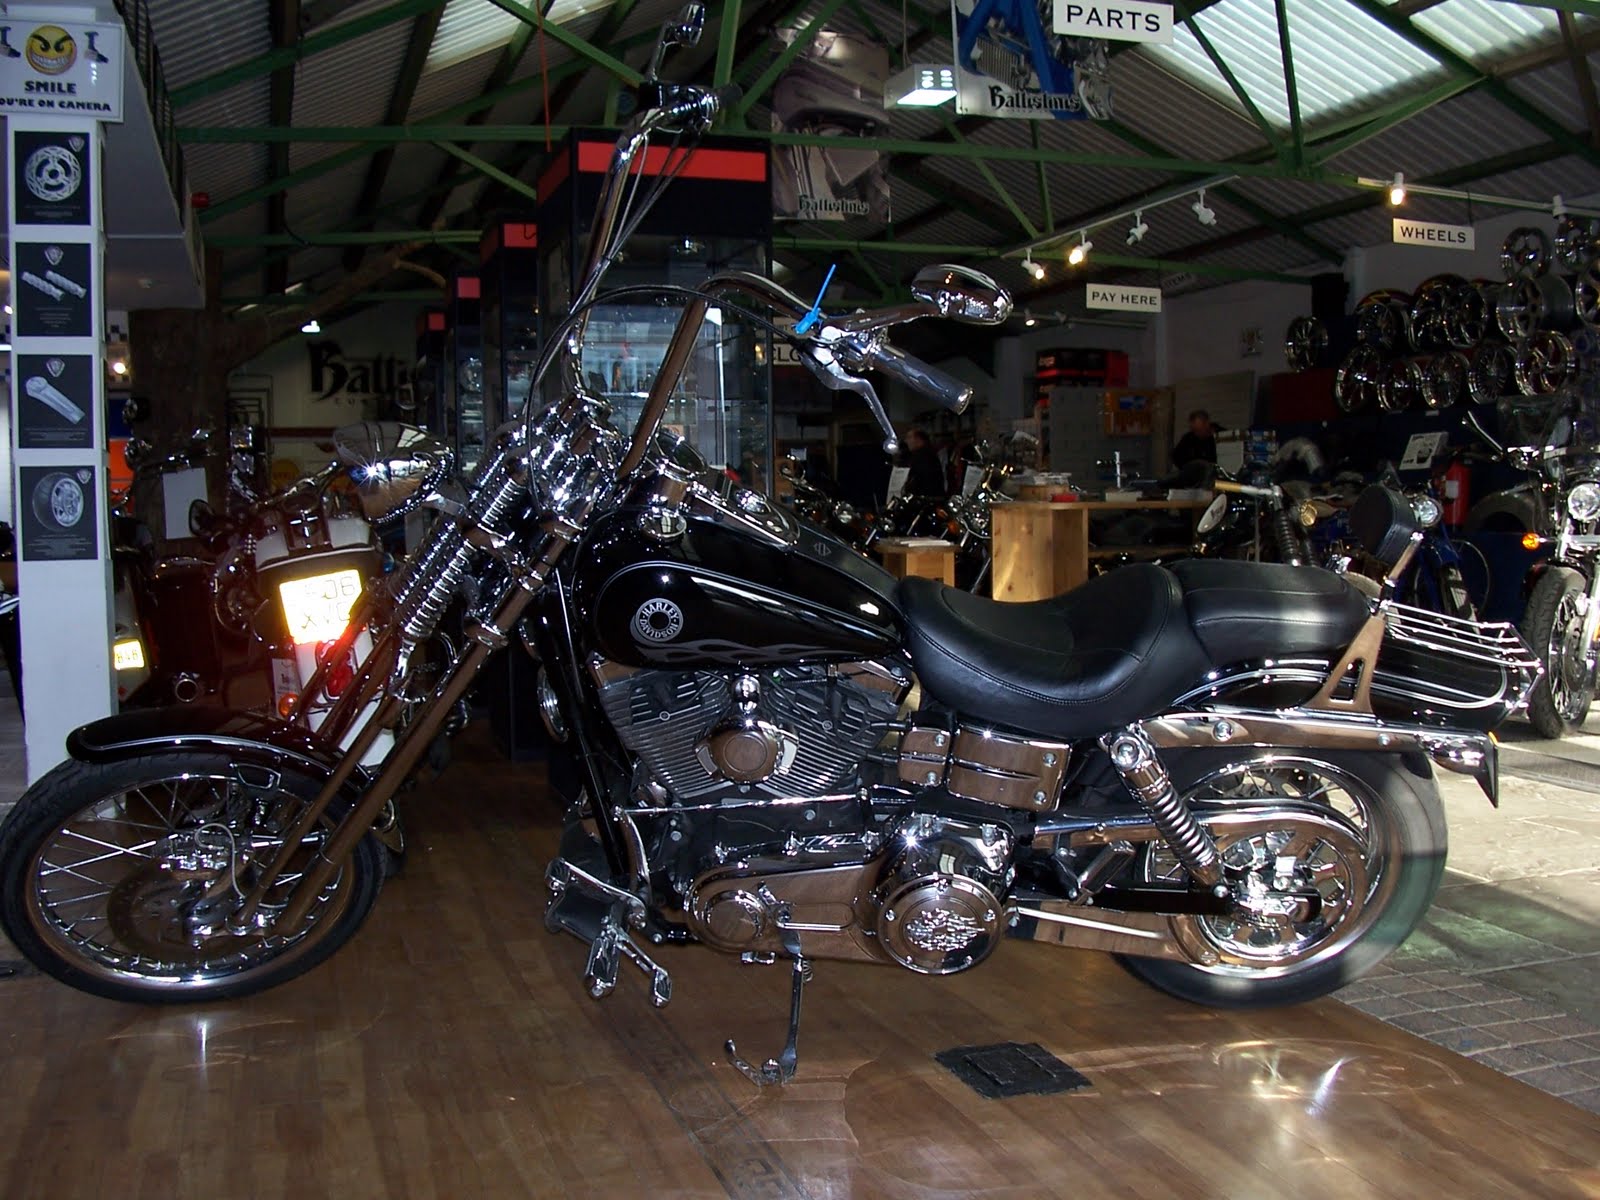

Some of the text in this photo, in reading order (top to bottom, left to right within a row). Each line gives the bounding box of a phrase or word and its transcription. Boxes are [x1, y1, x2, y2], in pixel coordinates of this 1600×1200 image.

[1067, 4, 1160, 32] PARTS
[24, 80, 77, 95] SMILE
[0, 98, 112, 112] OU'RE ON CAMERA
[1400, 226, 1466, 243] WHEELS
[1092, 291, 1157, 306] PAY HERE
[641, 602, 680, 619] HARLEY
[639, 618, 680, 639] DAVIDSON
